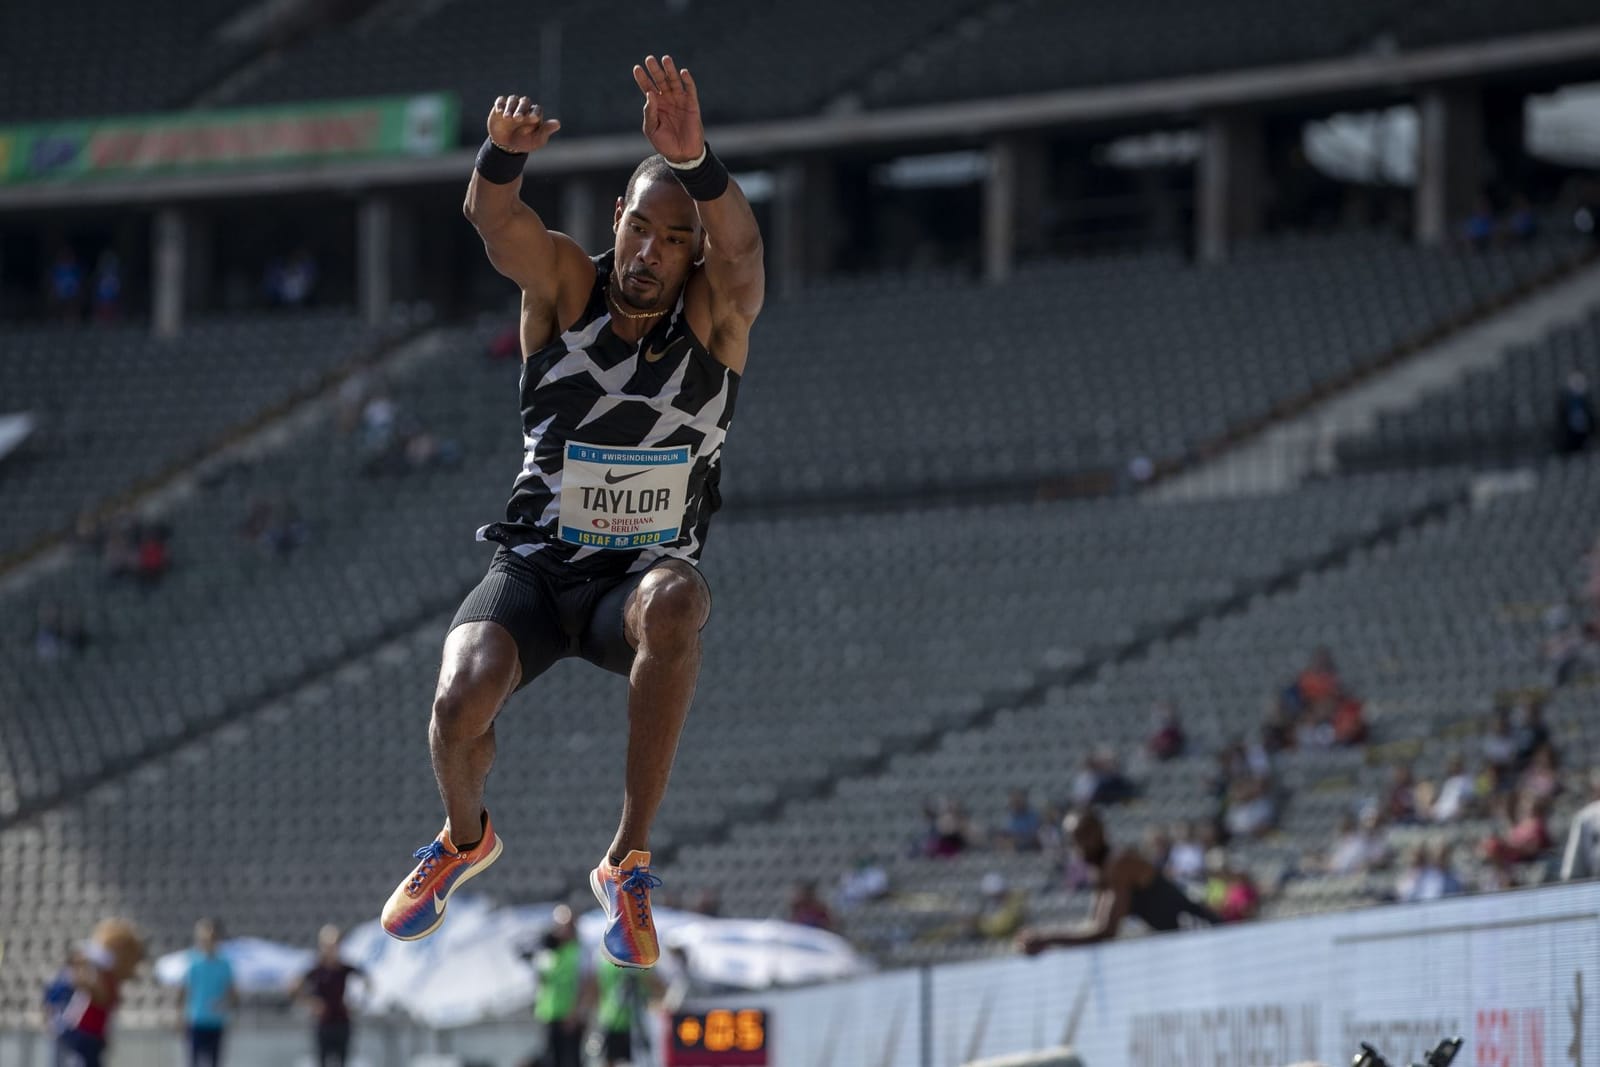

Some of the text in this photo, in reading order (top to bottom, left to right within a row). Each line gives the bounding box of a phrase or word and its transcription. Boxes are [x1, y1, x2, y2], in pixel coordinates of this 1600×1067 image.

[602, 453, 679, 462] #WIRSINDEINBERLIN
[580, 486, 670, 514] TAYLOR
[611, 517, 654, 525] SPIELBANK
[579, 533, 660, 546] ISTAF 2020
